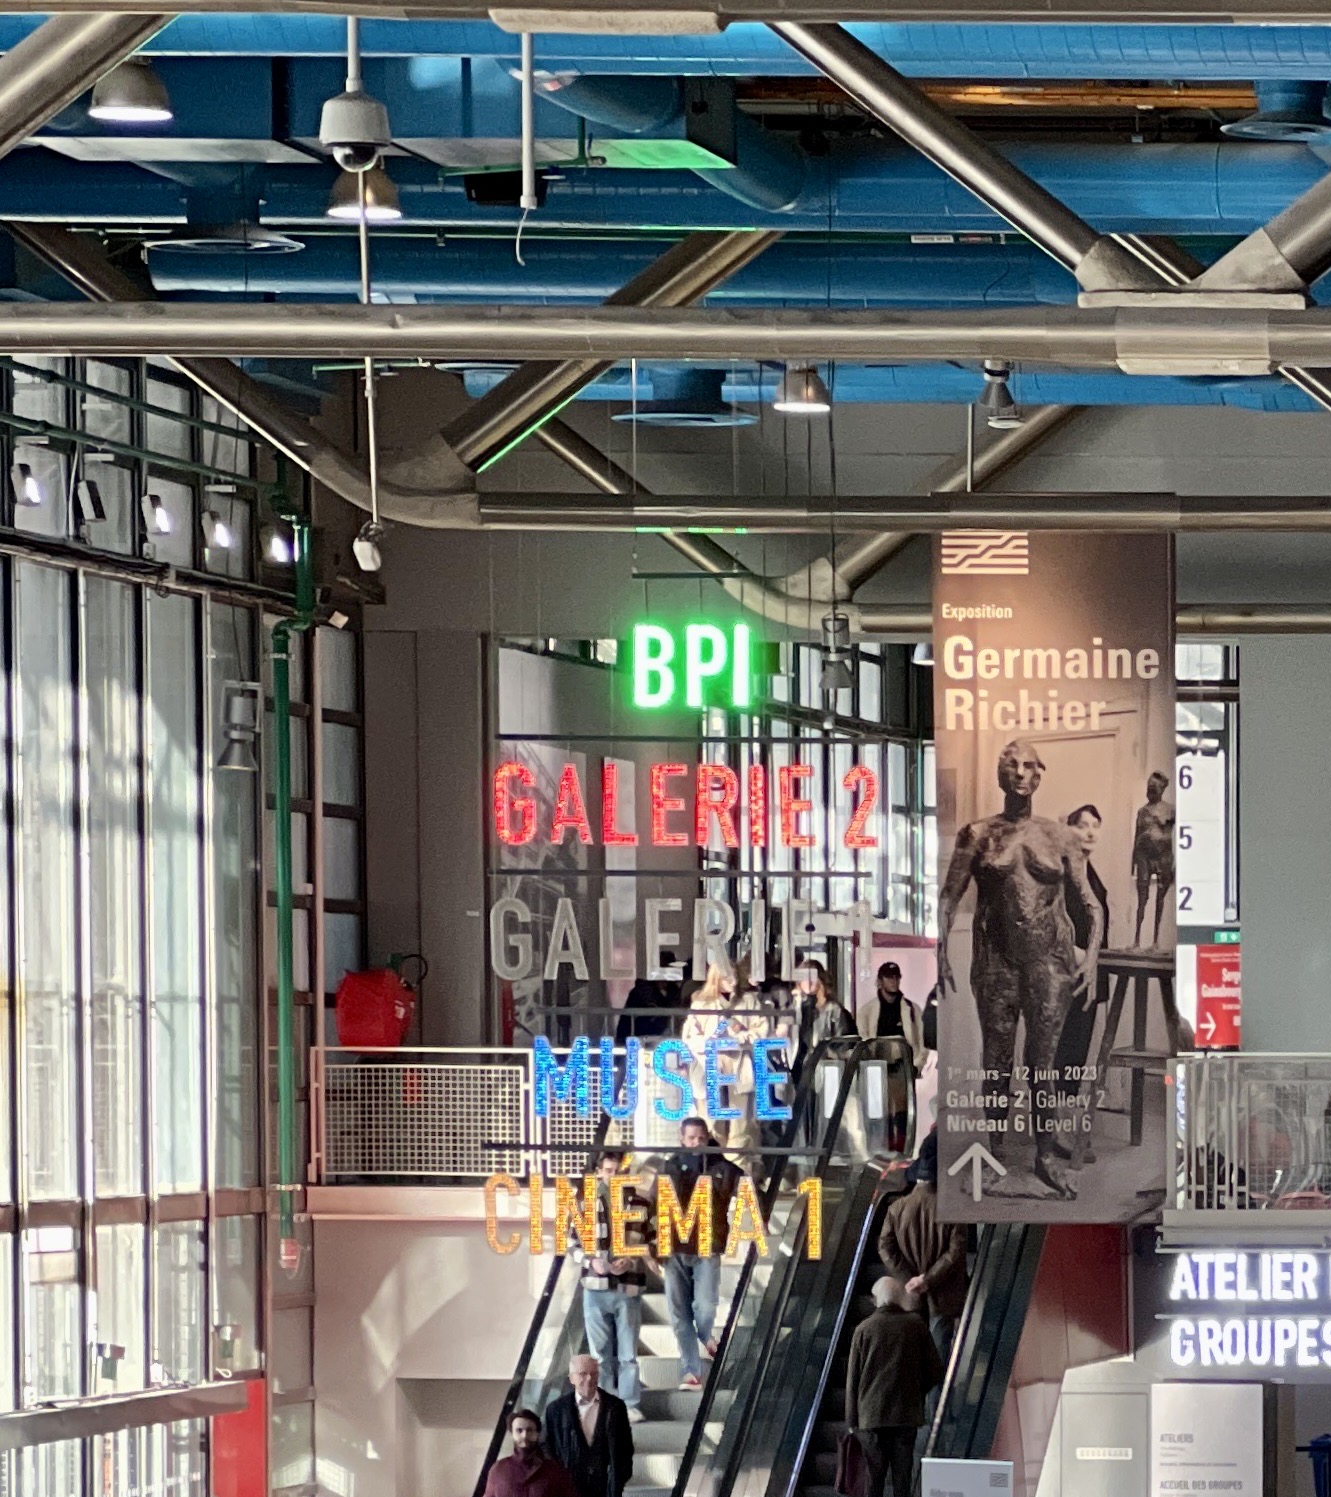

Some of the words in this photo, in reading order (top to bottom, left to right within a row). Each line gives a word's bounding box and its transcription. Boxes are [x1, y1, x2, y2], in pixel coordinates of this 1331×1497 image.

[942, 603, 1012, 621] Exposition
[633, 623, 750, 708] BPI
[943, 635, 1160, 680] Germaine
[944, 688, 1106, 731] Richier
[1179, 765, 1193, 789] 6
[494, 761, 815, 847] GALERIE
[842, 764, 879, 848] 2
[1179, 826, 1193, 850] 5
[1179, 887, 1193, 911] 2
[490, 898, 818, 982] GALERIE
[533, 1020, 793, 1121] MUSÉE
[966, 1069, 999, 1081] mars
[1015, 1066, 1030, 1081] 12
[1034, 1066, 1059, 1084] juin
[1064, 1066, 1097, 1081] 2023
[946, 1090, 1008, 1108] Galerie
[1014, 1091, 1025, 1108] 2
[1036, 1090, 1091, 1111] Gallery
[1096, 1090, 1105, 1108] 2
[946, 1115, 1008, 1132] Niveau
[1014, 1115, 1025, 1132] 6
[1036, 1115, 1077, 1132] Level
[1082, 1115, 1092, 1132] 6
[483, 1152, 769, 1259] CINÉMA
[798, 1176, 823, 1260] 1
[1170, 1253, 1318, 1300] ATELIER
